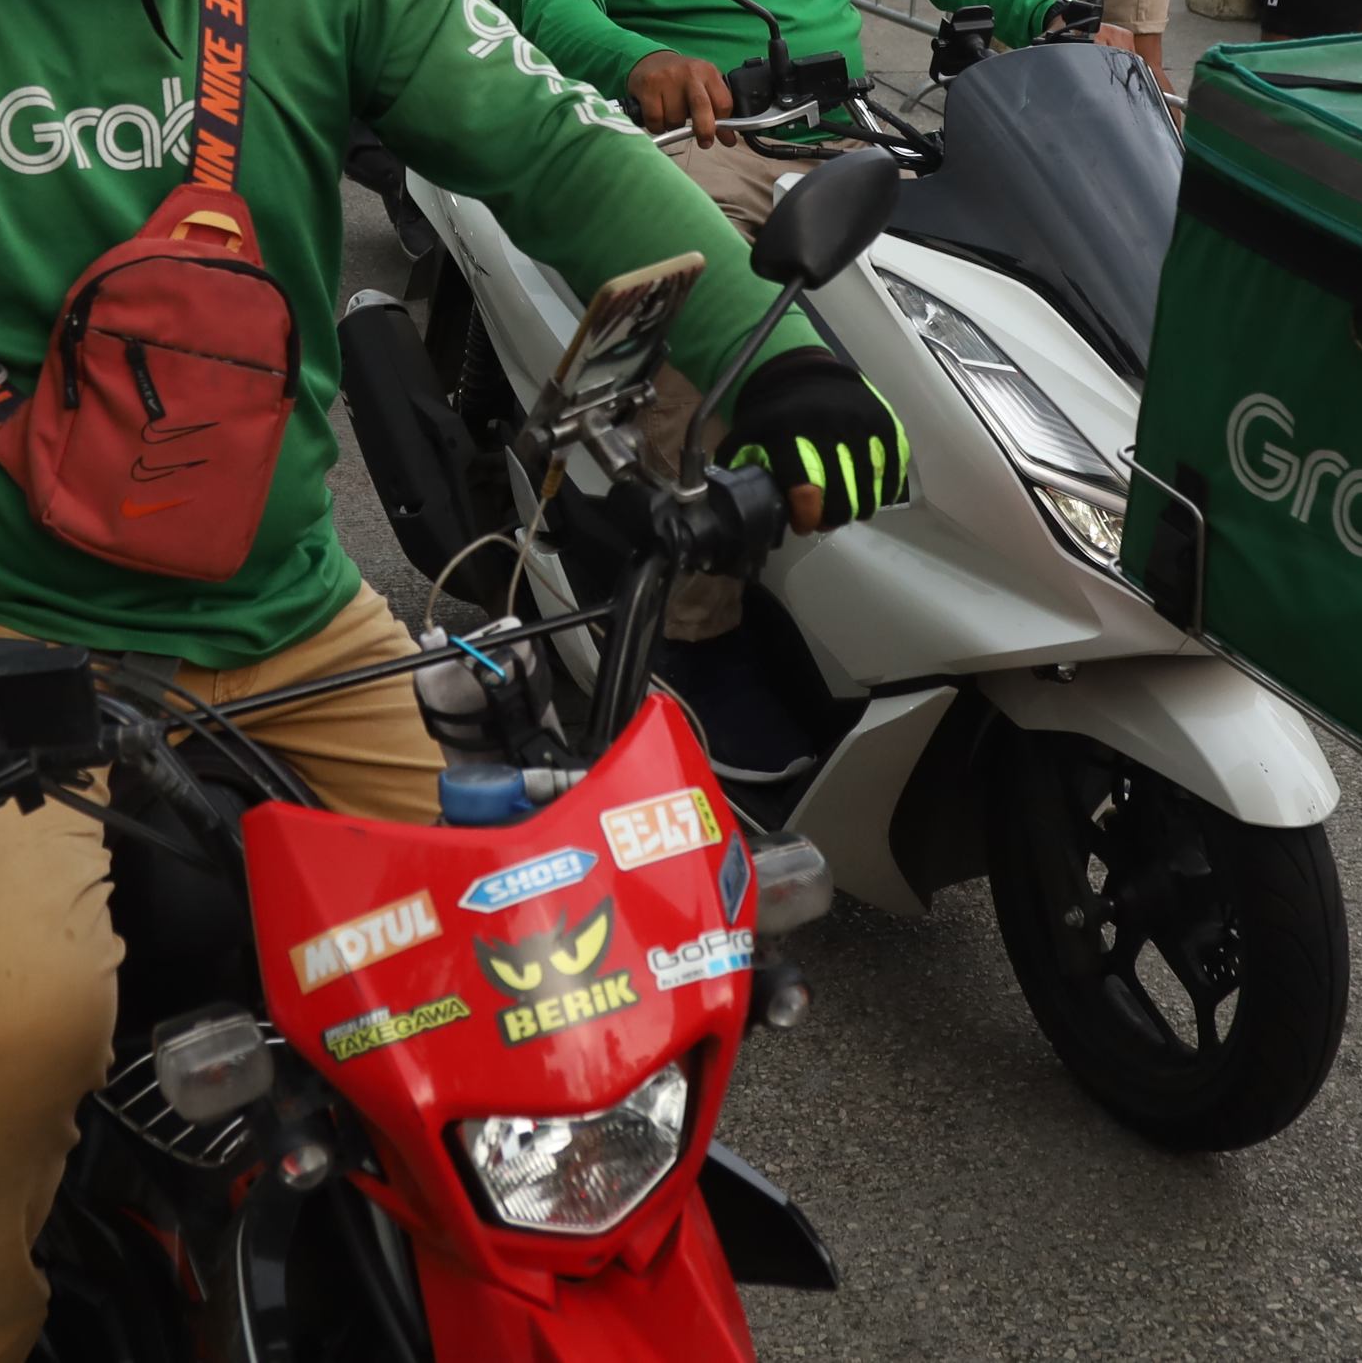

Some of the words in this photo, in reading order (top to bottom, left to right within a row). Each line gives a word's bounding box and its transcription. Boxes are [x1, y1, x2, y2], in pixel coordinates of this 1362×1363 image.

[200, 27, 242, 126] NIKE
[610, 795, 703, 863] ヨシムラ
[483, 852, 584, 904] SHOEI
[304, 898, 437, 984] MOTUL
[651, 929, 753, 971] GoPro
[330, 999, 467, 1059] TAKEGAWA
